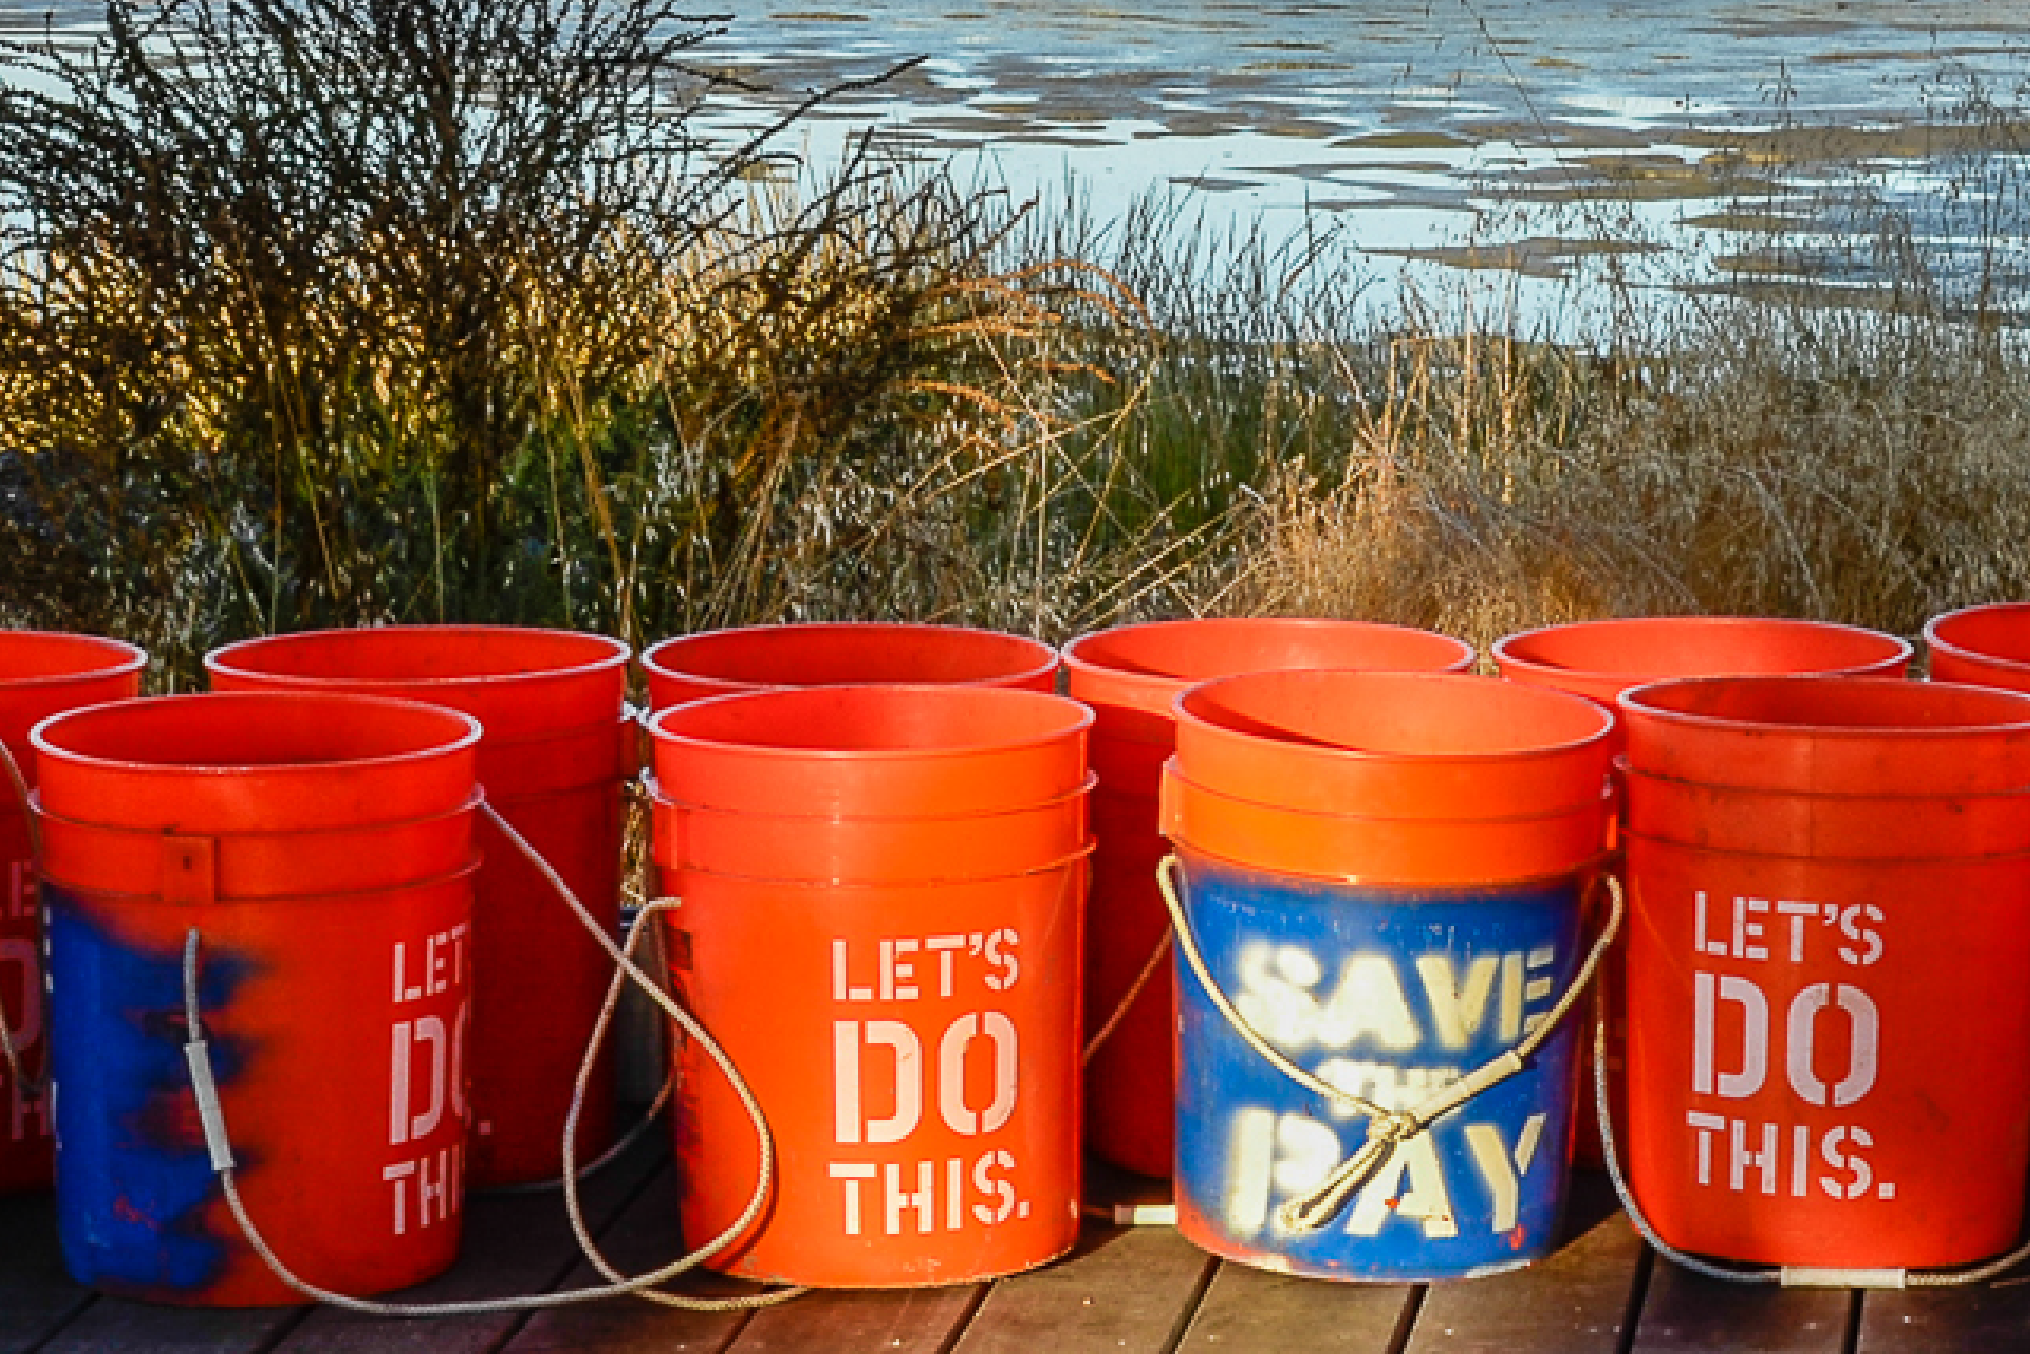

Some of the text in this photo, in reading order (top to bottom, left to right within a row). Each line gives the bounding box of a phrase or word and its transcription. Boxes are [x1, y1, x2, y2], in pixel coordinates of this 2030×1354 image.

[832, 928, 1019, 1000] LET'S
[1694, 890, 1885, 965] LET'S
[1234, 941, 1555, 1049] SAVE
[1692, 969, 1880, 1108] DO
[833, 1010, 1019, 1144] DO
[829, 1150, 1030, 1235] THIS.
[1686, 1109, 1896, 1200] THIS.
